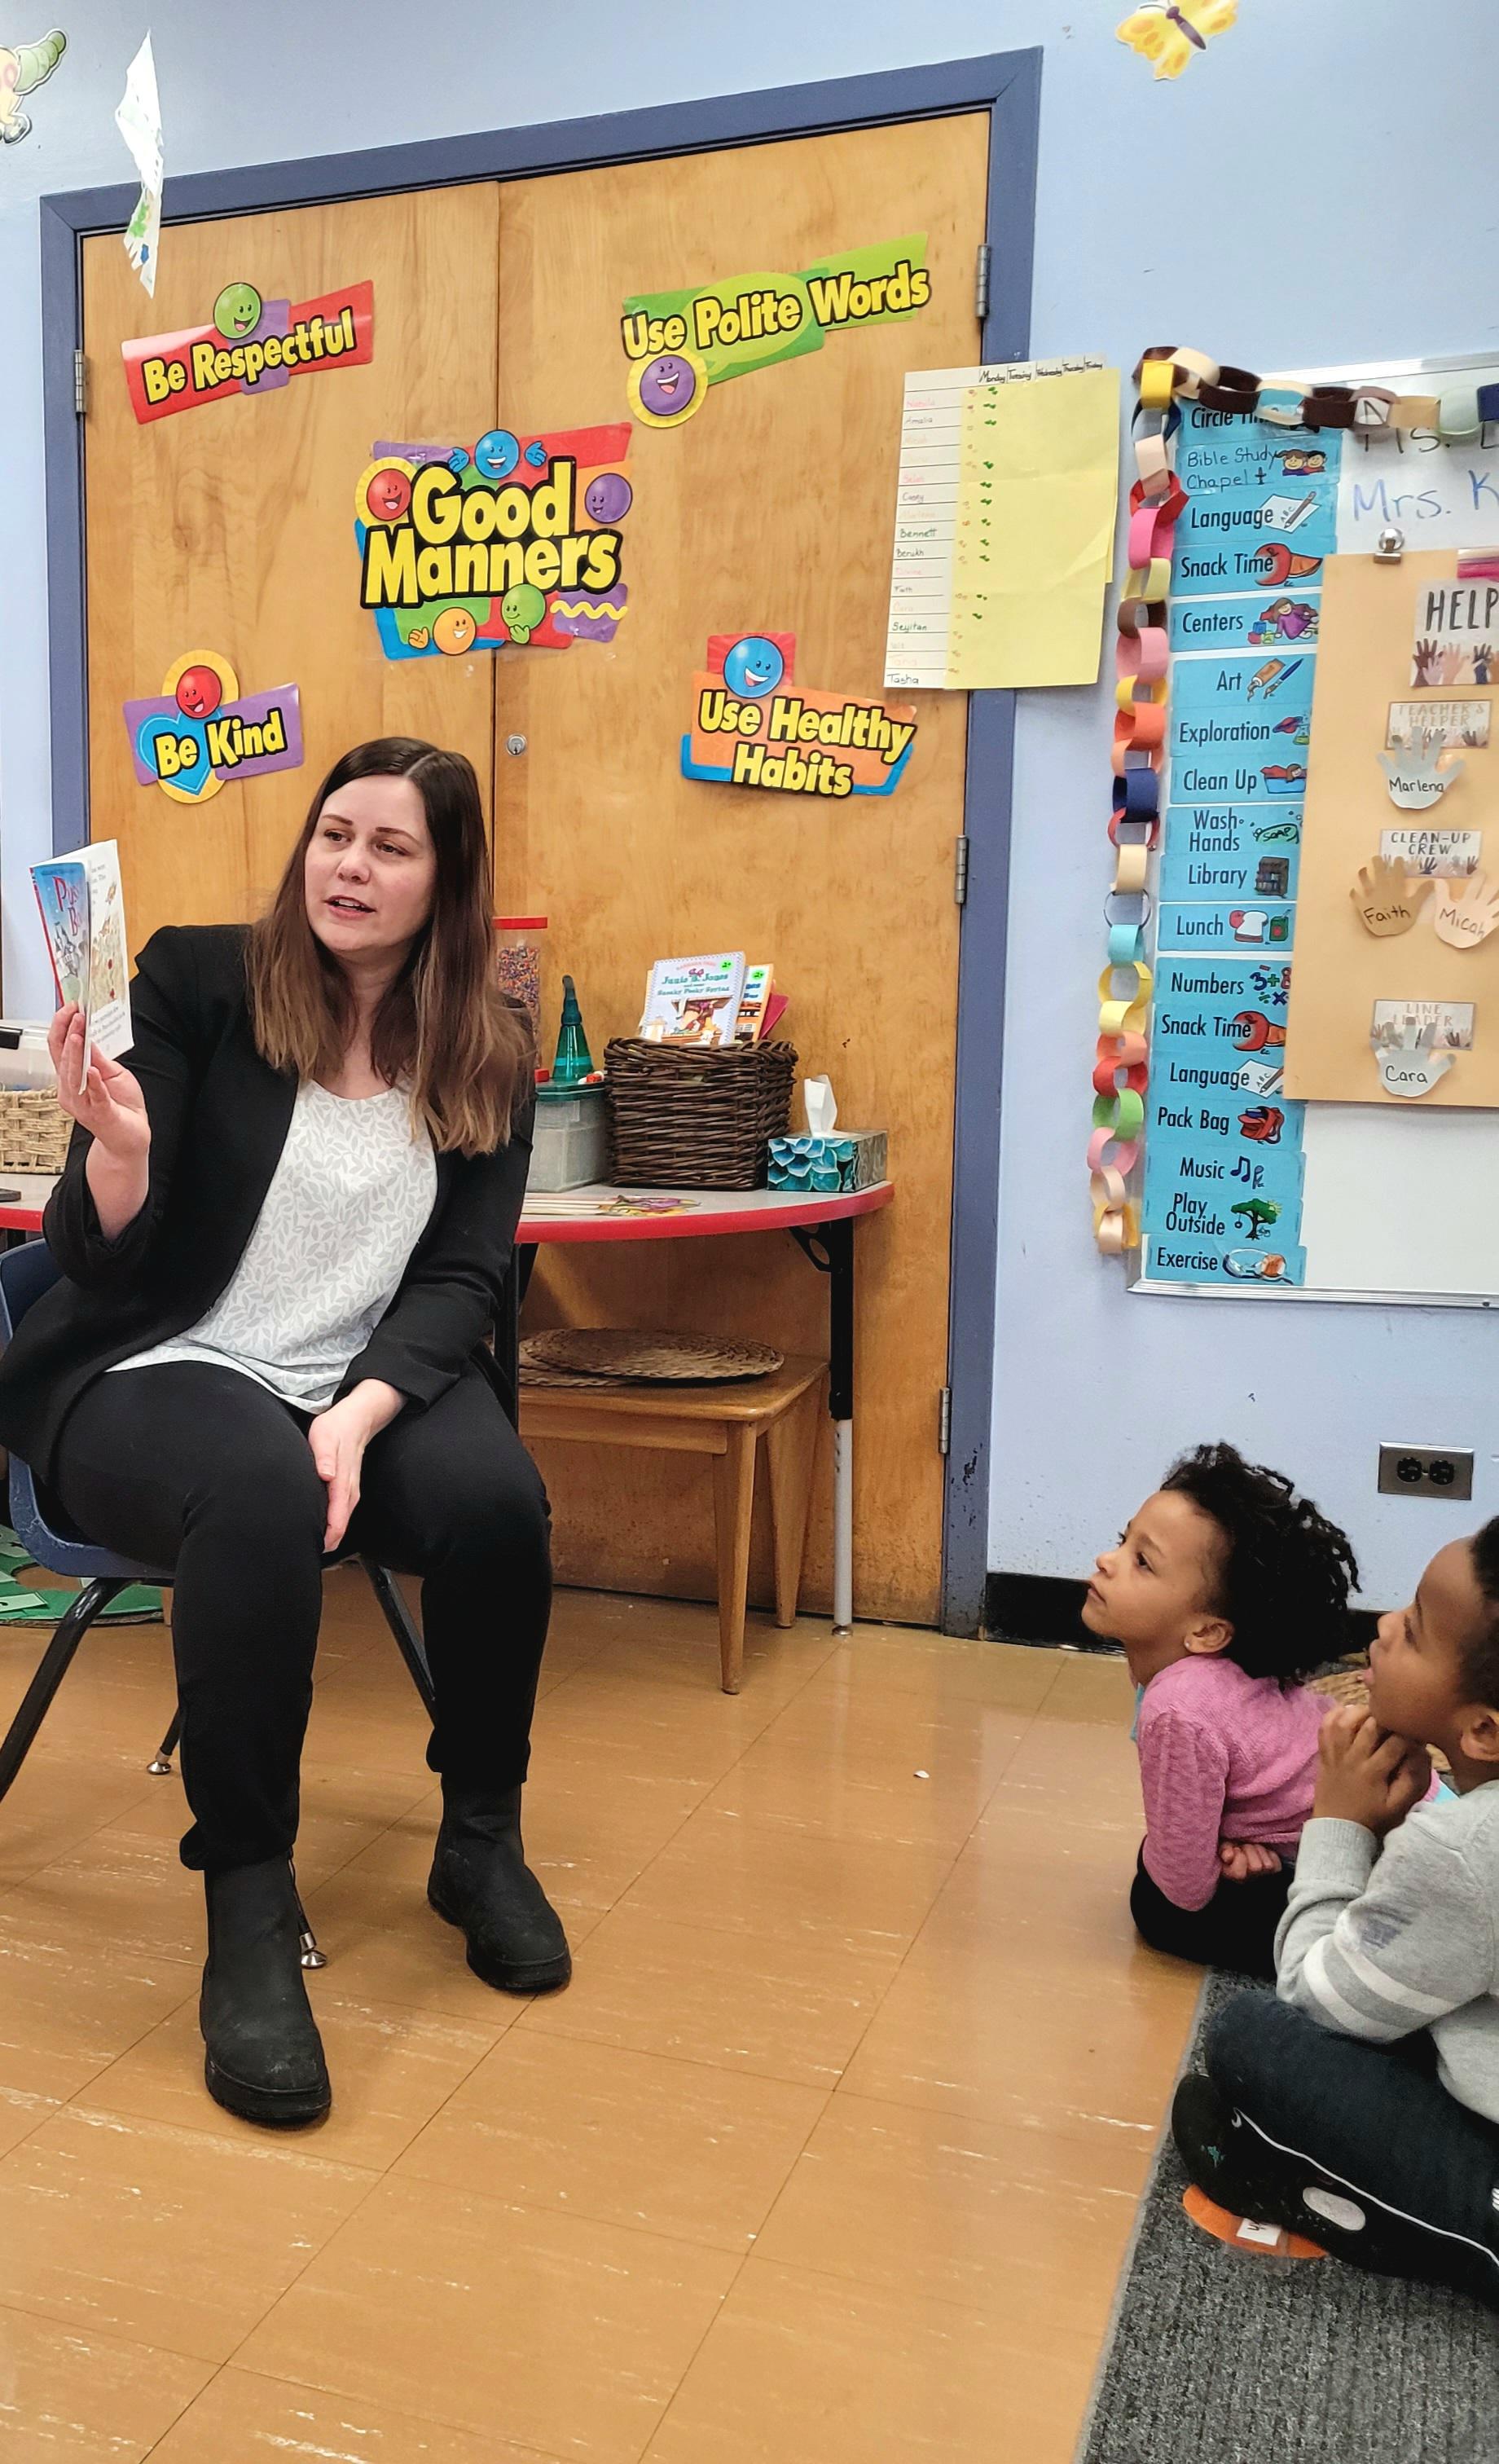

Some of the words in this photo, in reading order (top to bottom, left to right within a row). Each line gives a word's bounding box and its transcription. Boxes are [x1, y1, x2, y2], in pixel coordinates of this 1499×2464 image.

[622, 313, 686, 359] Use
[693, 292, 802, 349] Polite
[807, 261, 931, 326] Words
[143, 358, 187, 404] Be
[191, 306, 356, 389] Respectful
[978, 370, 1006, 384] Monday
[1191, 407, 1233, 429] Circle
[1187, 451, 1229, 468] Bible
[1234, 445, 1277, 470] Study
[1186, 469, 1248, 492] Chapel
[411, 458, 575, 545] Good
[1354, 478, 1452, 522] Mrs.
[1190, 507, 1274, 532] Language
[899, 528, 938, 539] Bennett
[363, 528, 620, 606] Manners
[1180, 552, 1228, 578] Snack
[1233, 553, 1274, 574] Time
[1182, 612, 1244, 633] Centers
[1426, 587, 1499, 633] HELP
[886, 673, 920, 684] Tasha
[1216, 671, 1242, 691] Art
[699, 690, 763, 736] Use
[768, 697, 916, 763] Healthy
[1179, 719, 1271, 747] Exploration
[1409, 715, 1470, 728] HELPER
[155, 733, 198, 777] Be
[205, 709, 285, 767] Kind
[732, 742, 852, 796] Habits
[1183, 769, 1229, 791] Clean
[1234, 771, 1258, 794] Up
[1389, 779, 1445, 794] Marlena
[1193, 807, 1237, 830] Wash
[1189, 831, 1241, 852] Hands
[1391, 831, 1472, 844] CLEAN-UP
[1408, 843, 1453, 856] CREW
[1188, 862, 1248, 889] Library
[1176, 915, 1224, 936] Lunch
[1363, 904, 1412, 926] Faith
[1439, 907, 1486, 939] Micah
[1170, 972, 1245, 996] Numbers
[1405, 1003, 1443, 1014] LINE
[1161, 1014, 1207, 1036] Snack
[1212, 1016, 1252, 1039] Time
[1169, 1062, 1251, 1091] Language
[1385, 1064, 1428, 1084] Cara
[1157, 1106, 1193, 1129] Pack
[1199, 1110, 1230, 1135] Bag
[1179, 1156, 1226, 1180] Music
[1172, 1192, 1208, 1219] Play
[1165, 1211, 1226, 1236] Outside
[1156, 1247, 1219, 1272] Exercise
